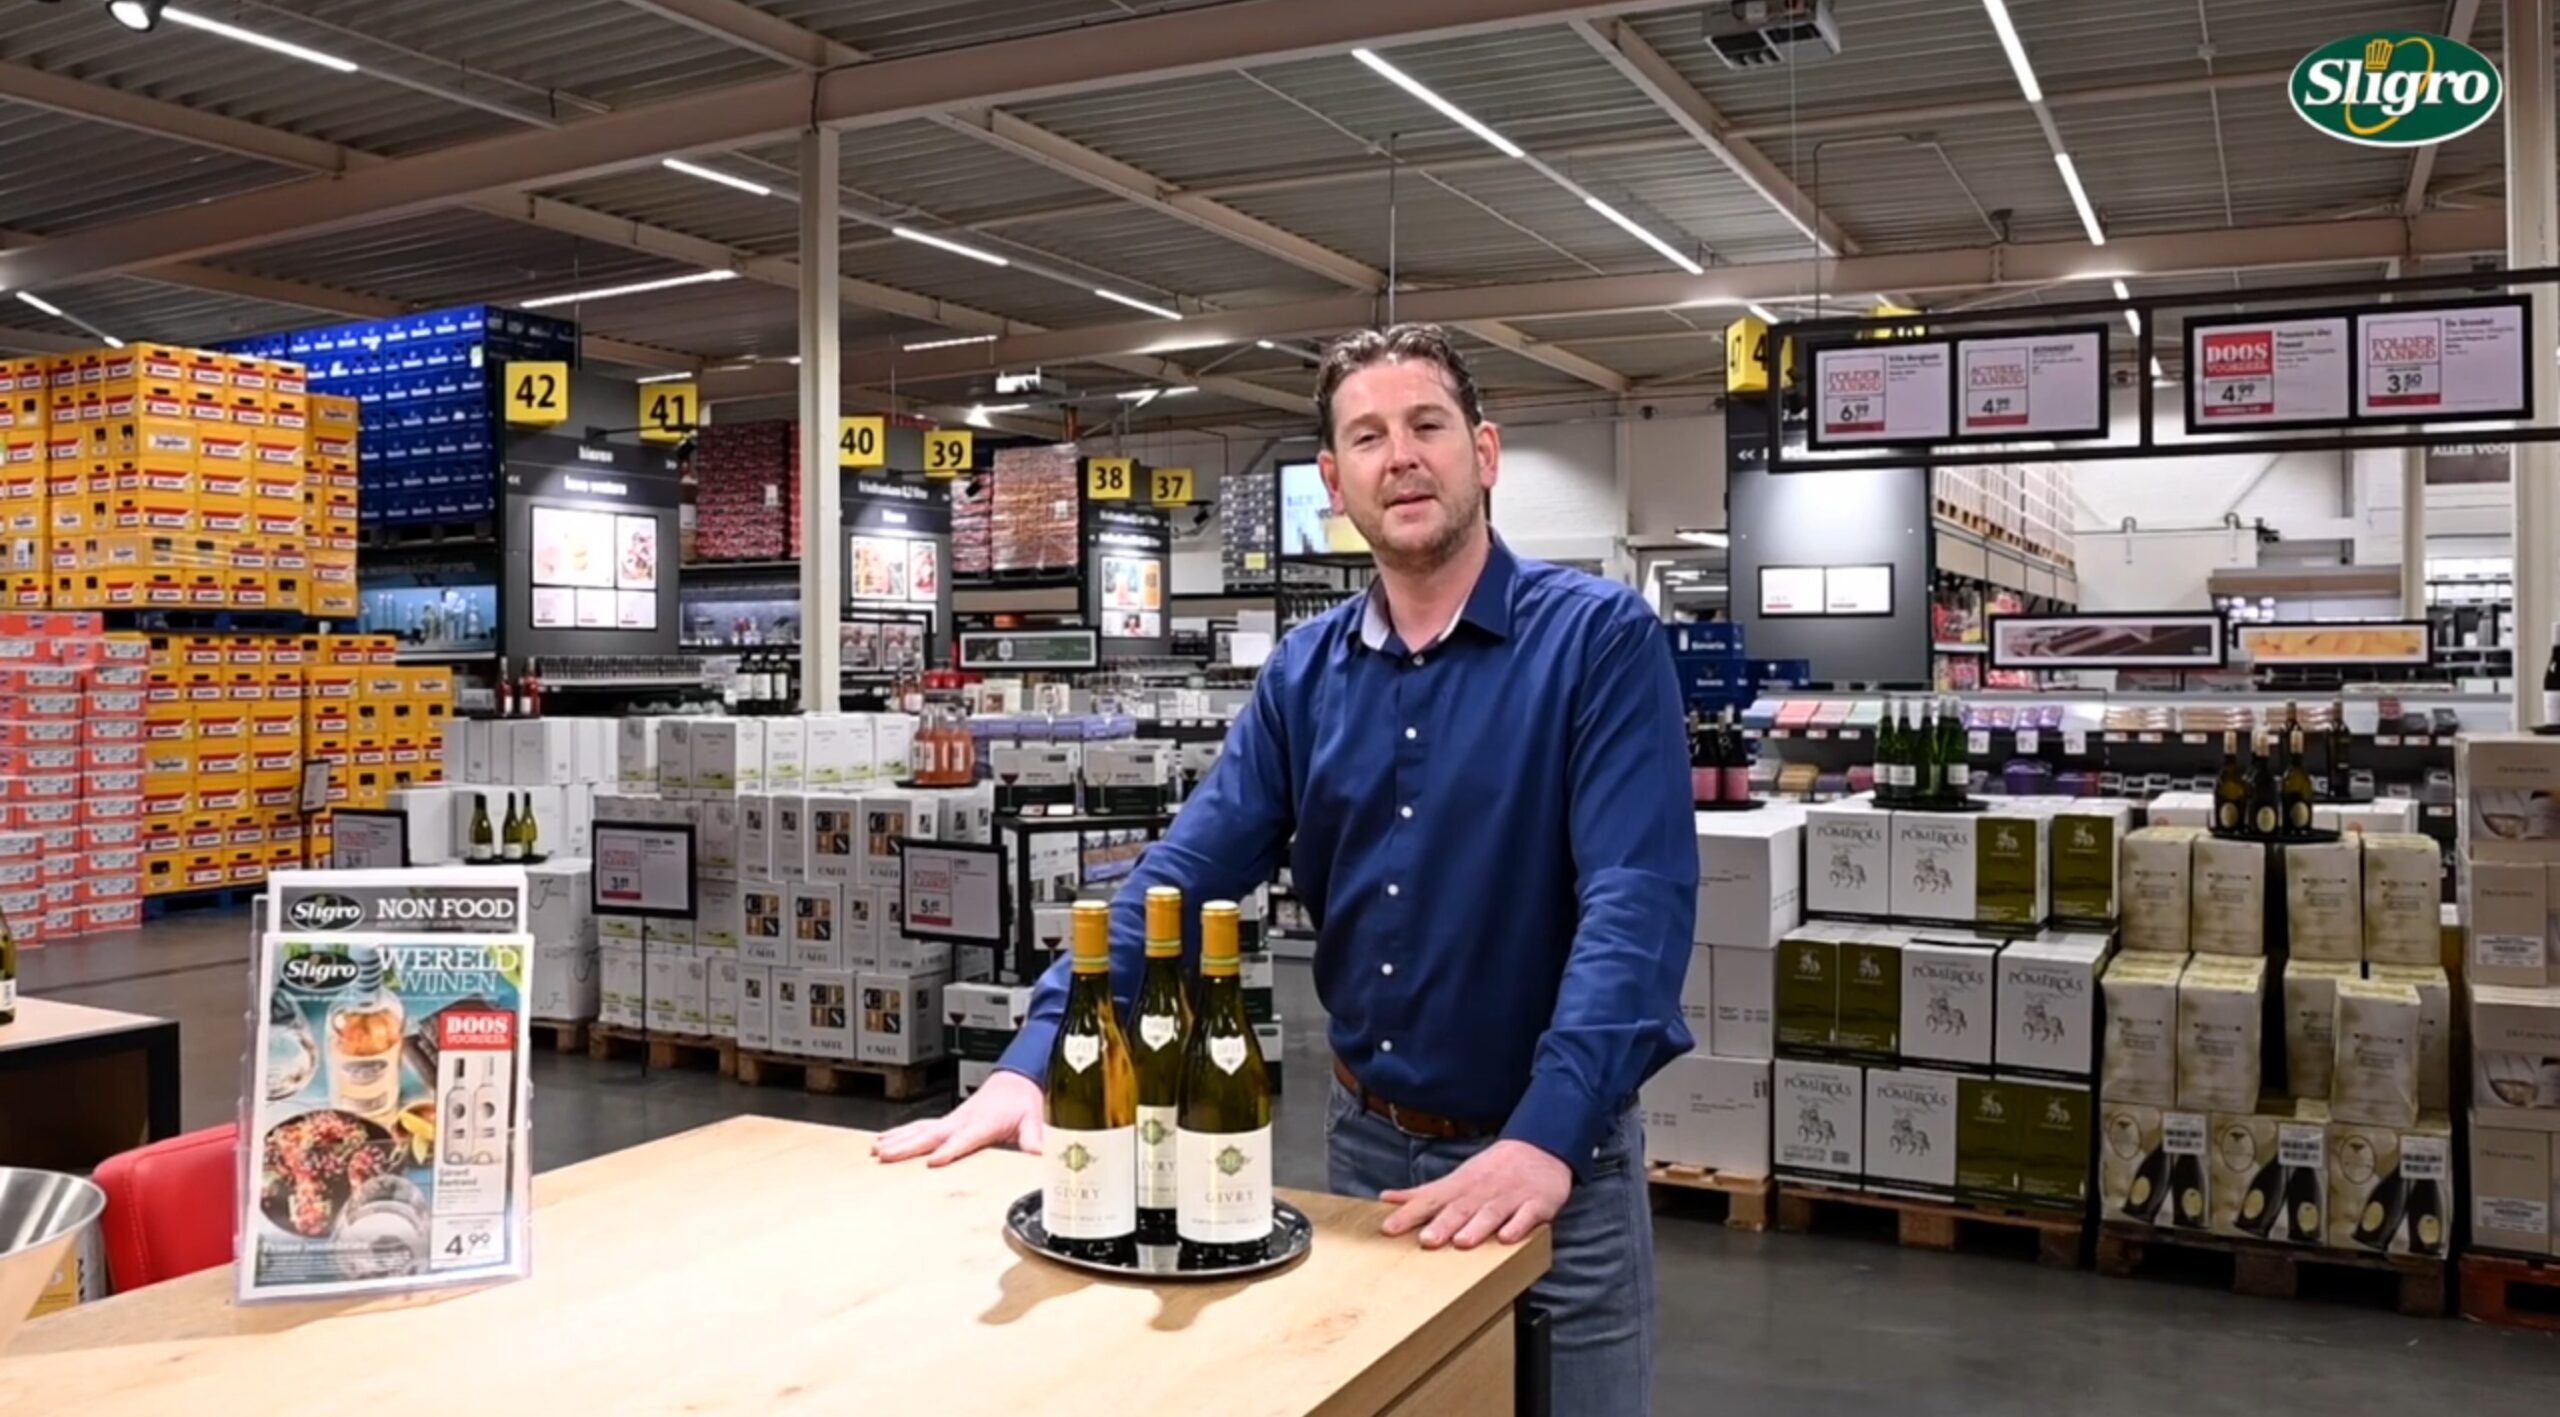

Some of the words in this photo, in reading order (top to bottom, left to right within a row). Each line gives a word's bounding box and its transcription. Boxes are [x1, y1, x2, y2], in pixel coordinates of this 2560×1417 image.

[2206, 342, 2269, 362] DOOS
[2371, 336, 2437, 351] FOLDER
[515, 374, 557, 409] 42
[649, 394, 686, 431] 41
[840, 426, 874, 455] 40
[2475, 442, 2510, 455] VOO
[931, 440, 964, 468] 39
[1094, 466, 1124, 491] 38
[1157, 475, 1185, 500] 37
[293, 901, 362, 927] Sligro
[376, 897, 437, 919] NON
[441, 897, 516, 919] FOOD
[377, 945, 520, 972] WERELD
[285, 960, 359, 986] Sligro
[398, 971, 497, 993] WIJNEN
[447, 1015, 508, 1034] DOOS
